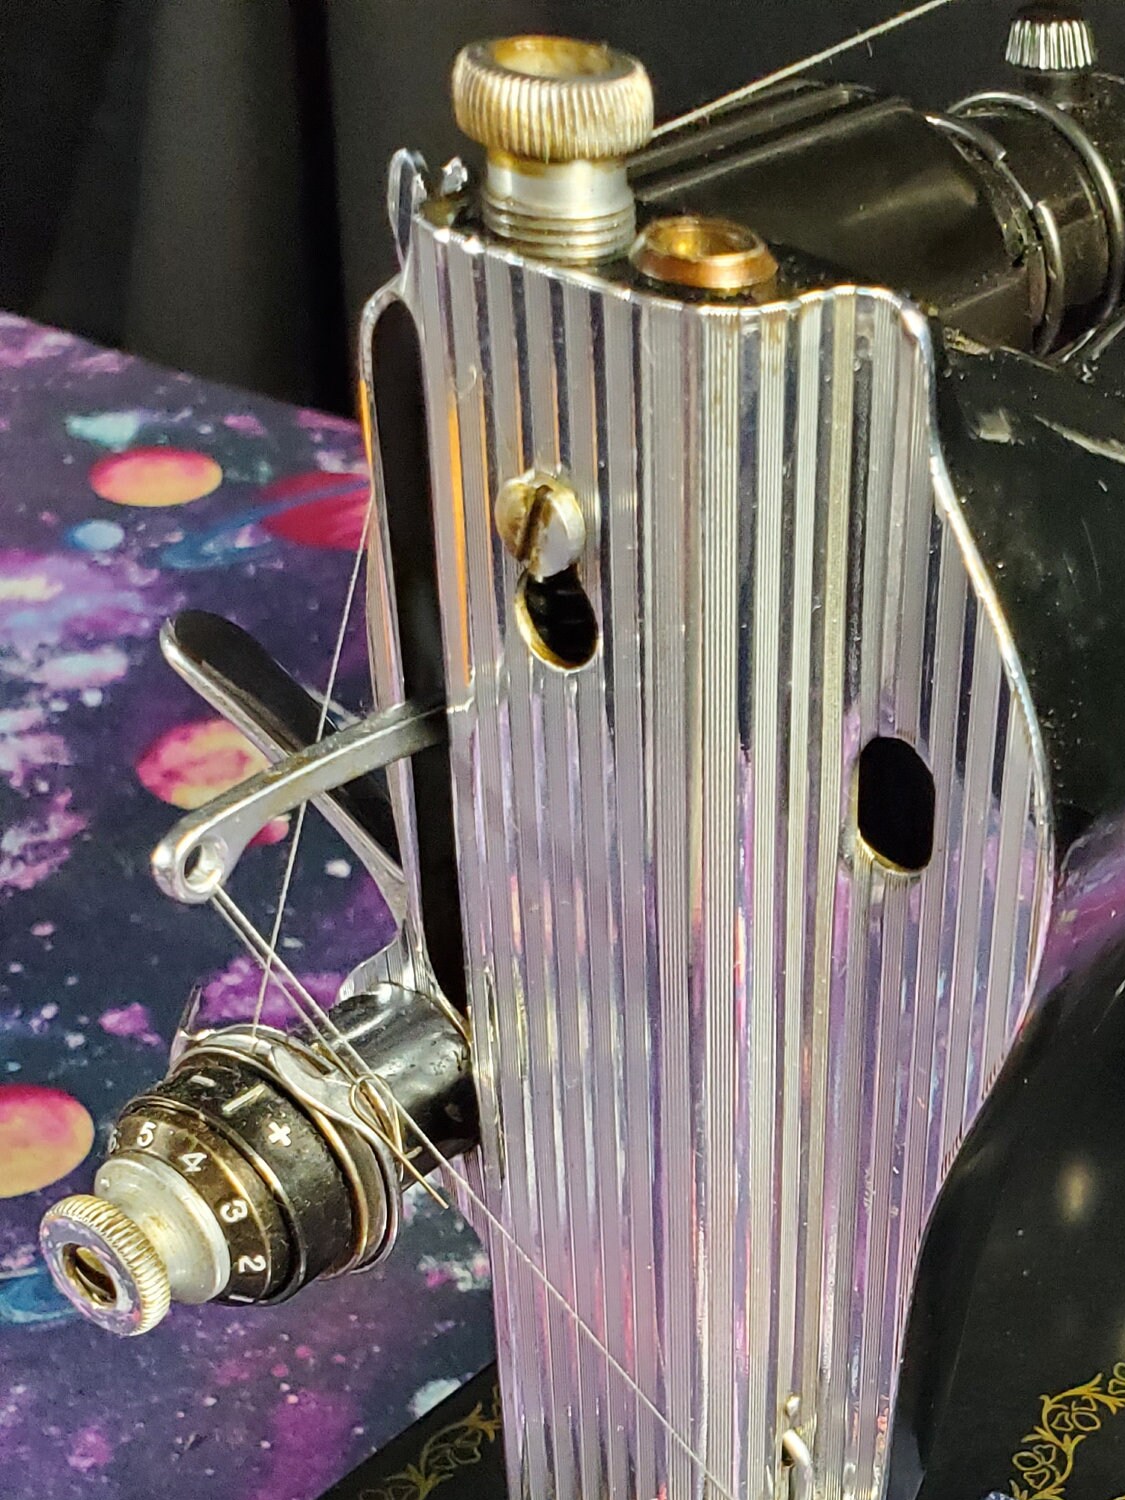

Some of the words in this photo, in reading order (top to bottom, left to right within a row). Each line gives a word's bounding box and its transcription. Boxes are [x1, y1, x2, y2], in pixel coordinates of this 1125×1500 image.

[136, 1121, 158, 1148] 5
[179, 1151, 209, 1174] 4
[219, 1199, 249, 1225] 3
[237, 1253, 267, 1274] 2
